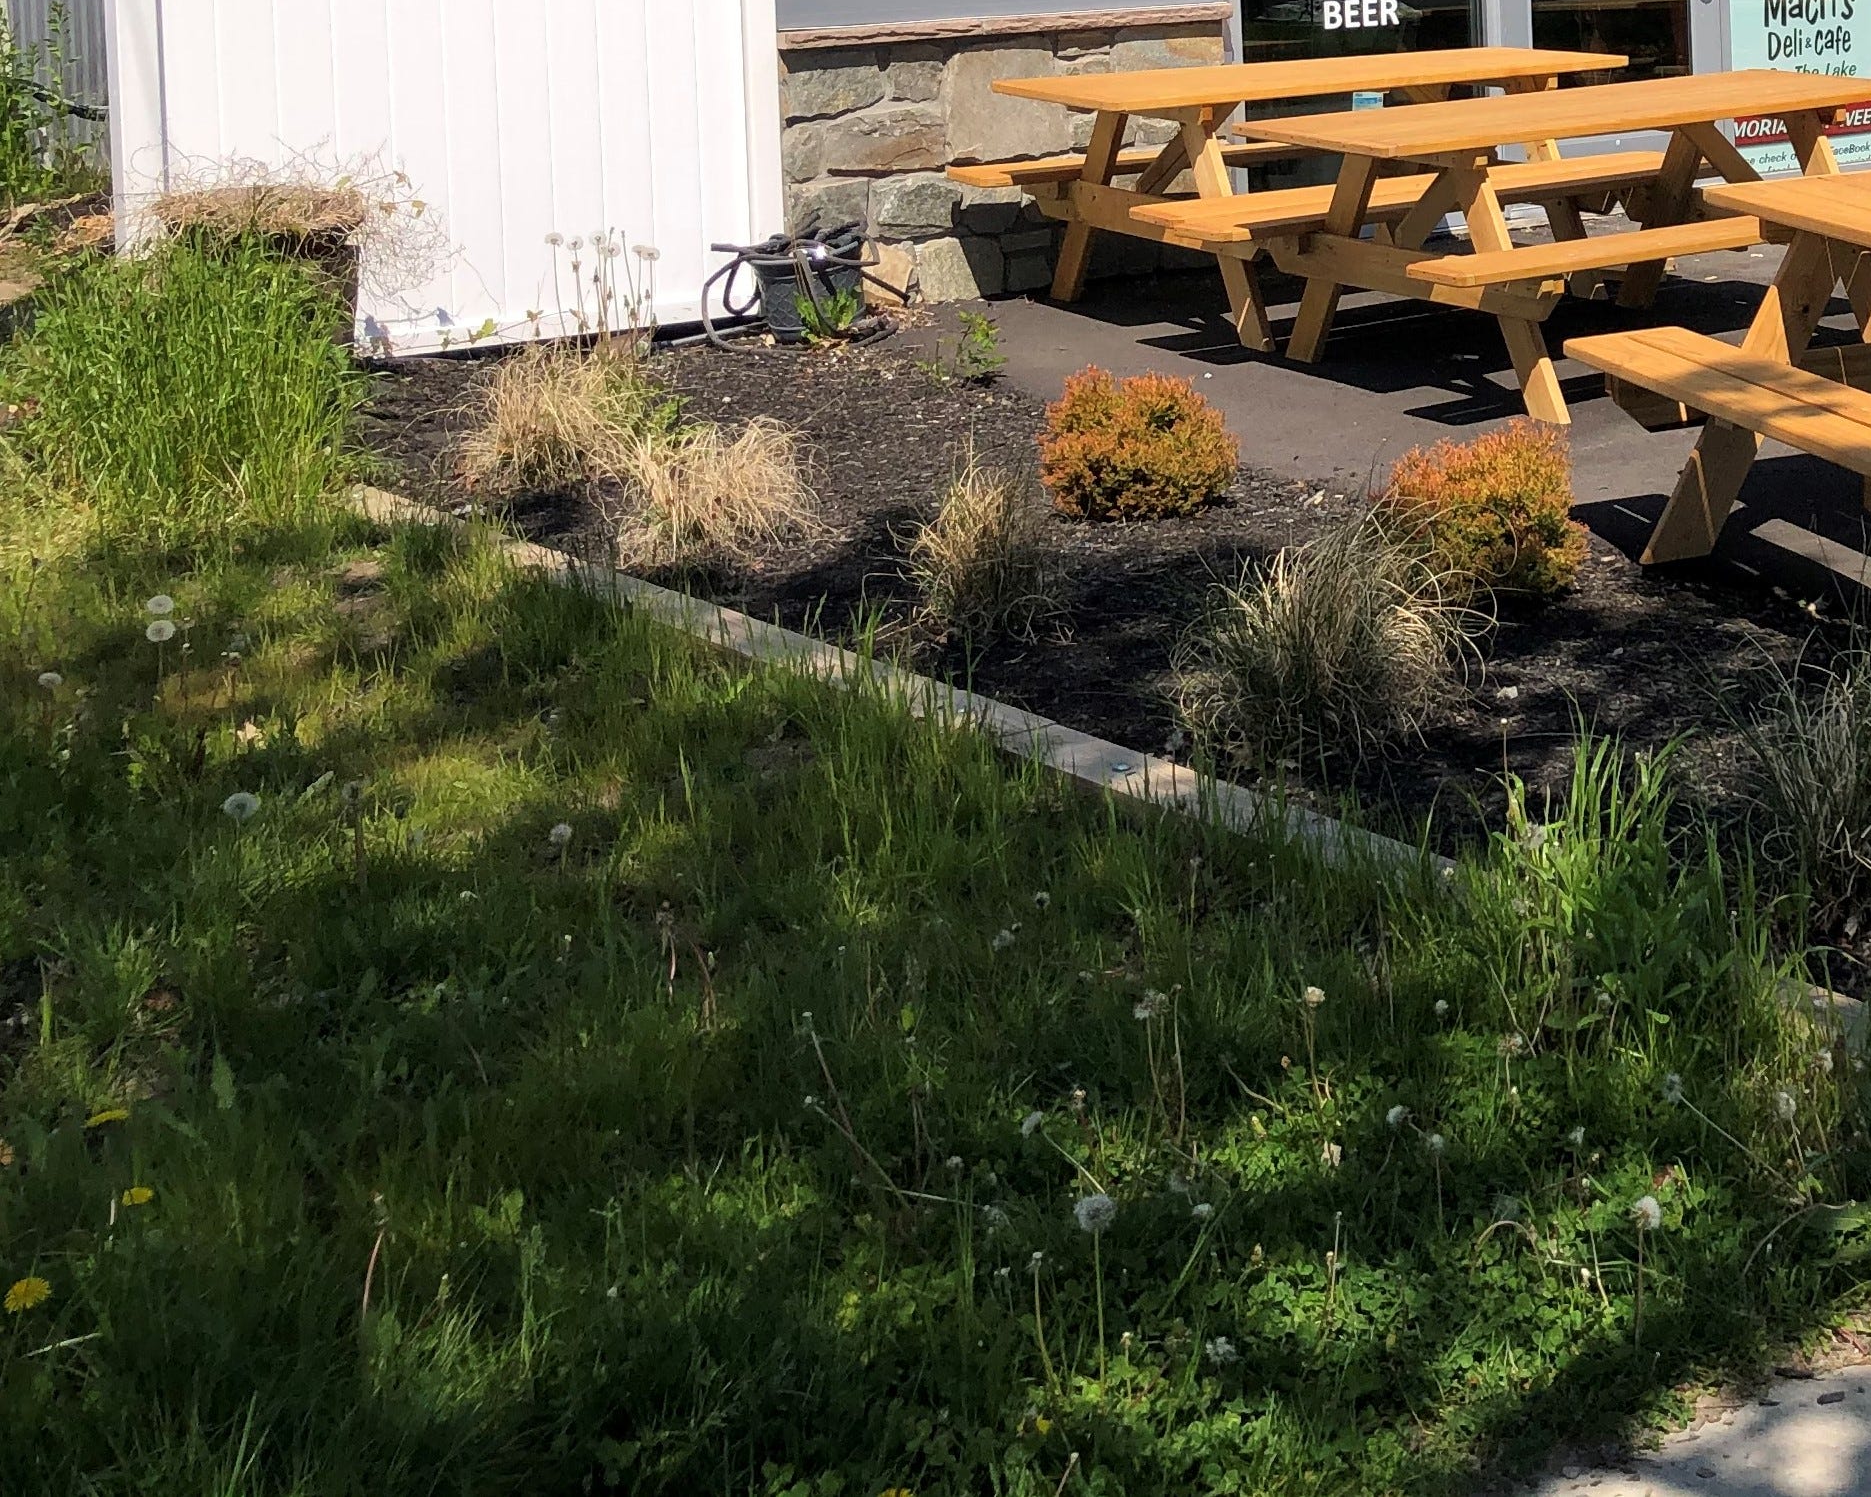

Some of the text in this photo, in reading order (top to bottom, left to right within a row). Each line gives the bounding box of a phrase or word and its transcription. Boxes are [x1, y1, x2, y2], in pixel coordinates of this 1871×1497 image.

[1767, 28, 1803, 62] Deli
[1804, 37, 1813, 49] &
[1825, 60, 1857, 78] Lake
[1831, 141, 1870, 156] aceBook
[1758, 151, 1788, 165] check
